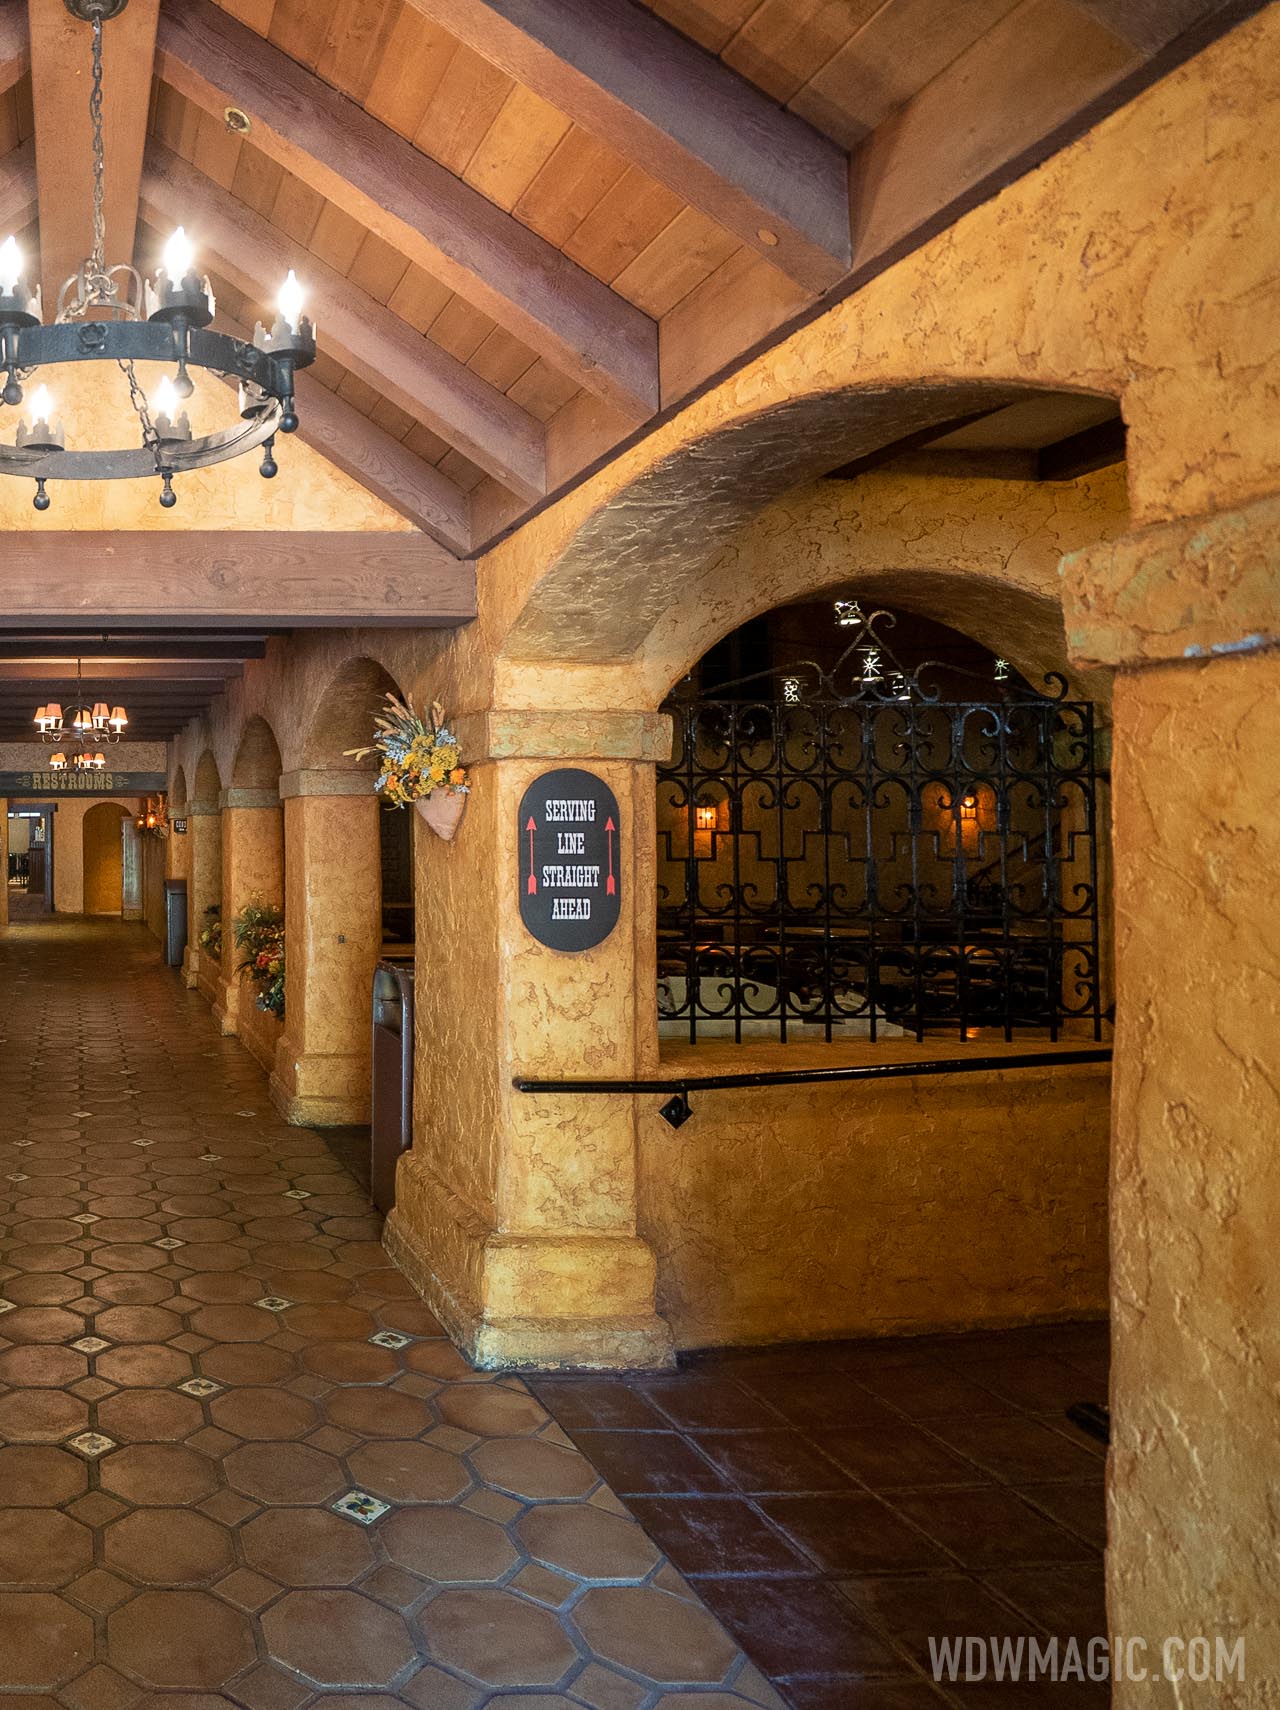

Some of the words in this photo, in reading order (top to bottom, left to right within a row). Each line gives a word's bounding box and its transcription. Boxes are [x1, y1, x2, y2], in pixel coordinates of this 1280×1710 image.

[32, 772, 113, 790] RESTROOMS
[545, 799, 596, 822] SERVING
[557, 832, 585, 855] LINE
[542, 865, 600, 888] STRAIGHT
[551, 898, 591, 920] AHEAD
